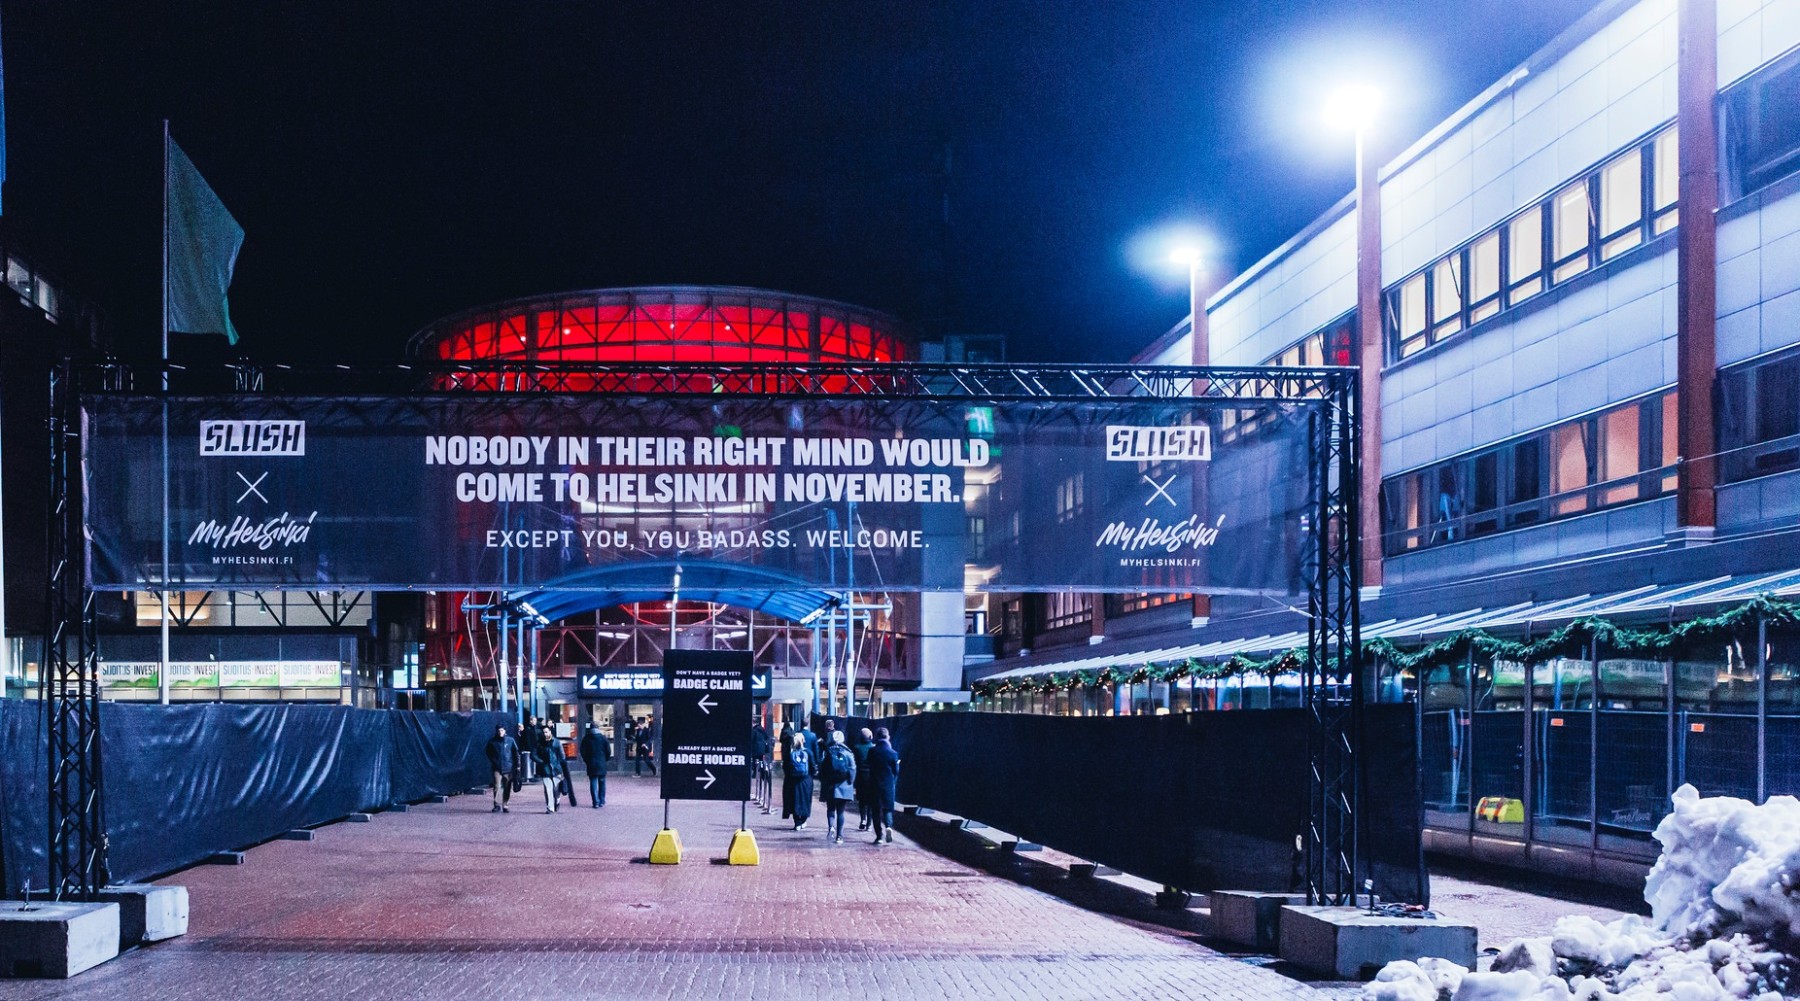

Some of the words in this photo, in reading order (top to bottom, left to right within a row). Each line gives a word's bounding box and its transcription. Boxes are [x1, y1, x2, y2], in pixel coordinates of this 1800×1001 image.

[204, 424, 301, 452] SLUSH
[1110, 430, 1206, 457] SLUSH
[425, 435, 551, 466] NOBODY
[558, 436, 590, 466] IN
[596, 436, 686, 466] THEIR
[693, 436, 786, 467] RIGHT
[793, 437, 874, 467] MIND
[880, 438, 990, 468] WOULD
[456, 472, 544, 503] COME
[550, 472, 590, 503] TO
[597, 472, 737, 504] HELSINKI
[744, 472, 776, 503] IN
[784, 473, 960, 503] NOVEMBER.
[486, 530, 574, 548] EXCEPT
[582, 530, 635, 551] YOU,
[645, 530, 690, 549] YOU
[698, 530, 797, 548] BADASS.
[806, 530, 930, 548] WELCOME.
[212, 556, 294, 565] MYHELSINKI.FI
[1120, 558, 1201, 567] MYHELSINKI.FI
[193, 664, 216, 676] INVEST
[599, 678, 633, 690] BADGE
[633, 678, 665, 690] CLAIM
[673, 678, 708, 690] BADGE
[709, 679, 743, 691] CLAIM
[667, 753, 703, 765] BADGE
[703, 754, 746, 766] HOLDER
